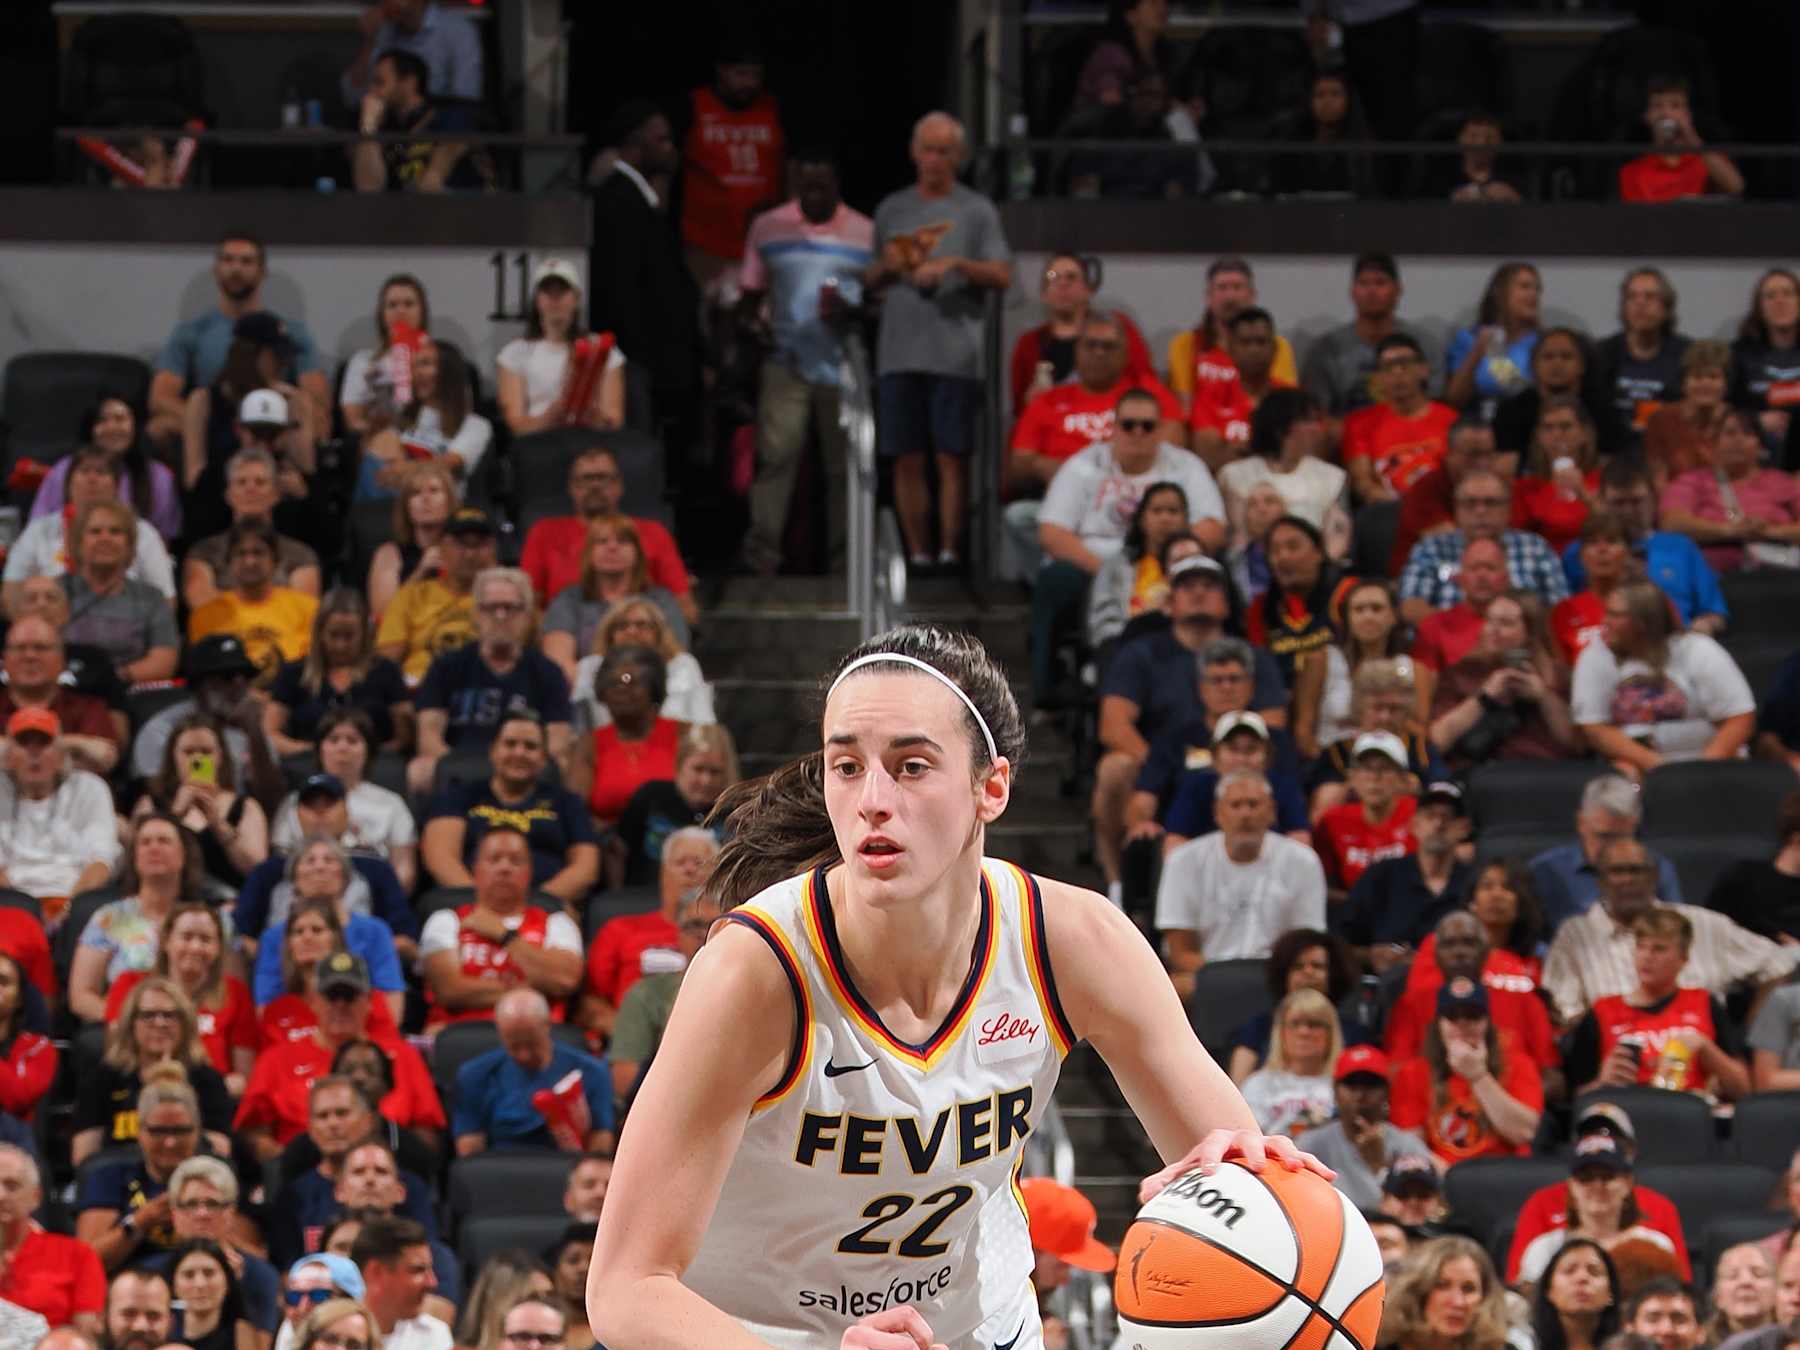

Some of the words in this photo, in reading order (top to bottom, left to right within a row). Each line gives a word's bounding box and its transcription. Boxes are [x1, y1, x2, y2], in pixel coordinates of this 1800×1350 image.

[978, 1012, 1039, 1046] Lilly
[793, 1085, 1033, 1176] FEVER
[834, 1184, 975, 1258] 22
[1162, 1171, 1246, 1230] lson
[799, 1266, 952, 1317] salesforce
